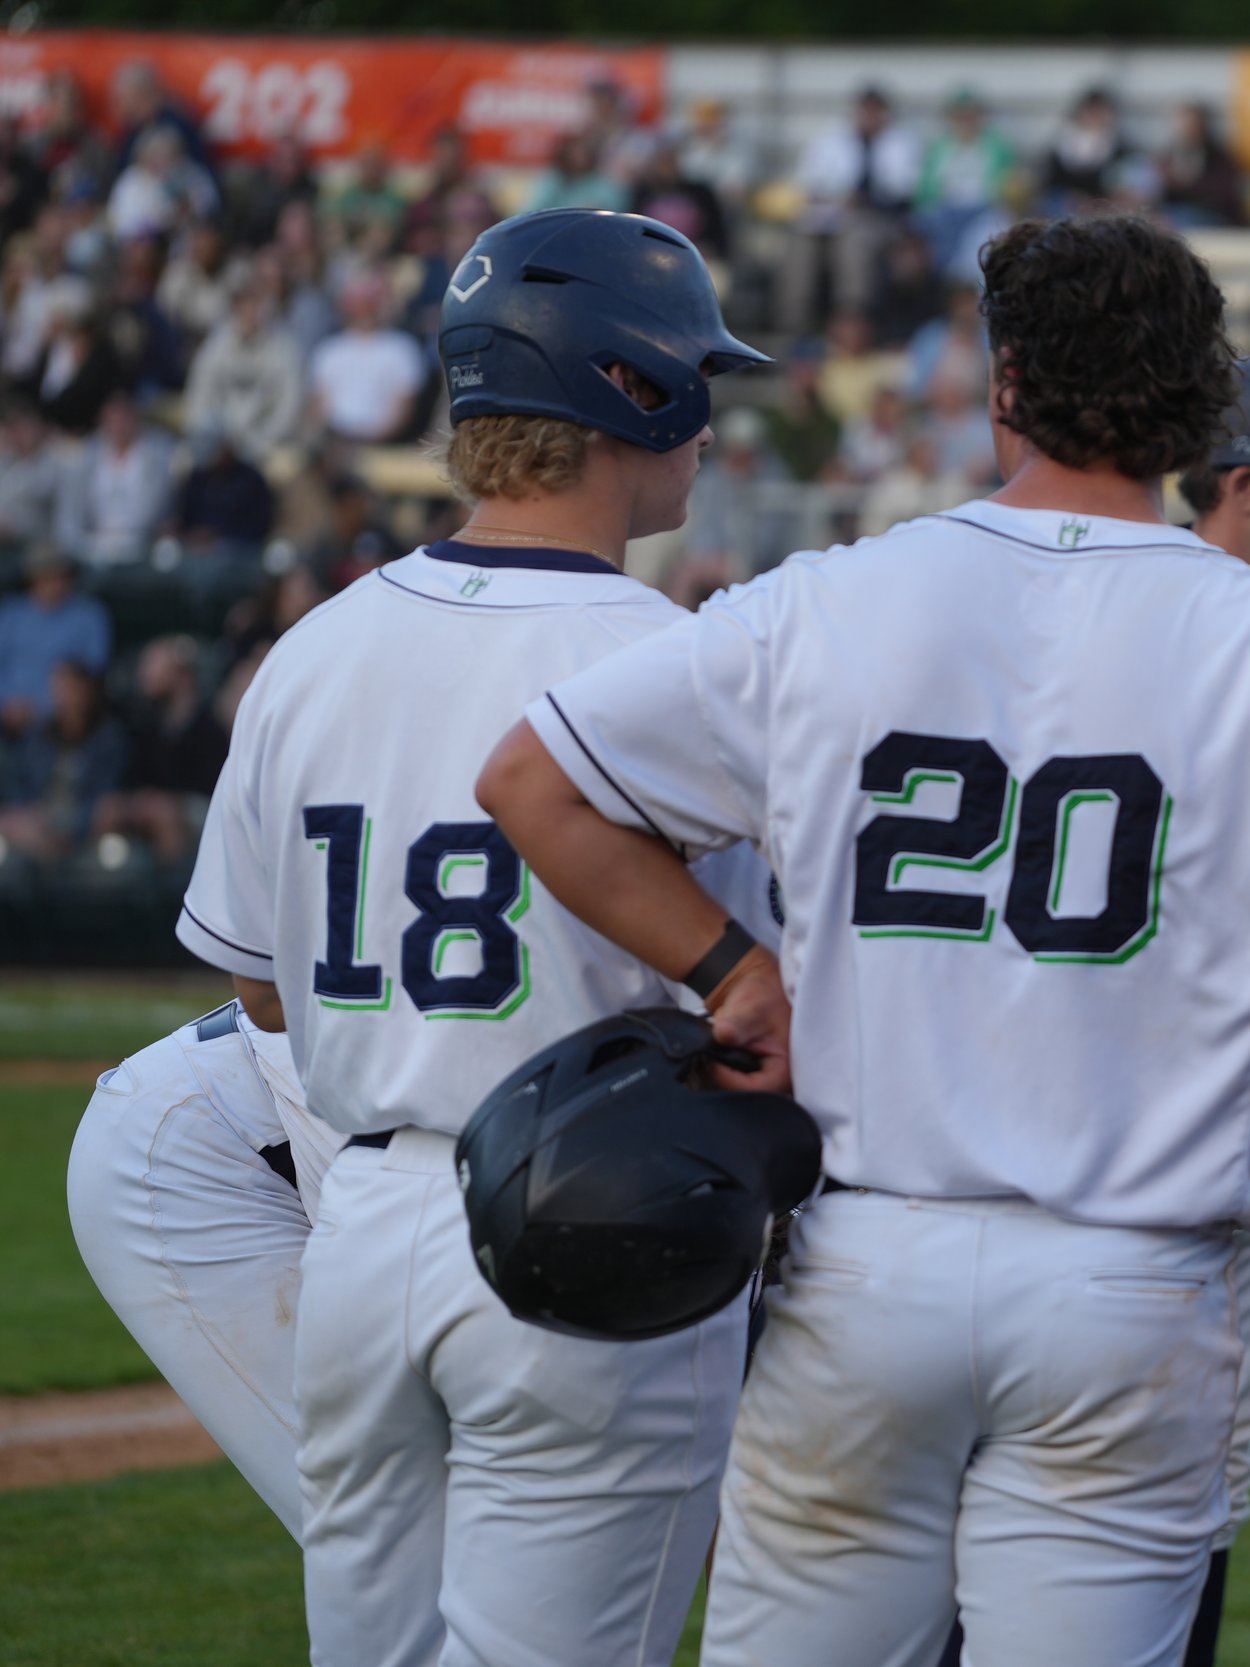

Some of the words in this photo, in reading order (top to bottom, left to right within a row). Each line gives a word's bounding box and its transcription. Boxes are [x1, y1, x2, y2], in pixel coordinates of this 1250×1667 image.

[203, 59, 351, 145] 202
[303, 803, 531, 1021] 18
[852, 730, 1172, 965] 20
